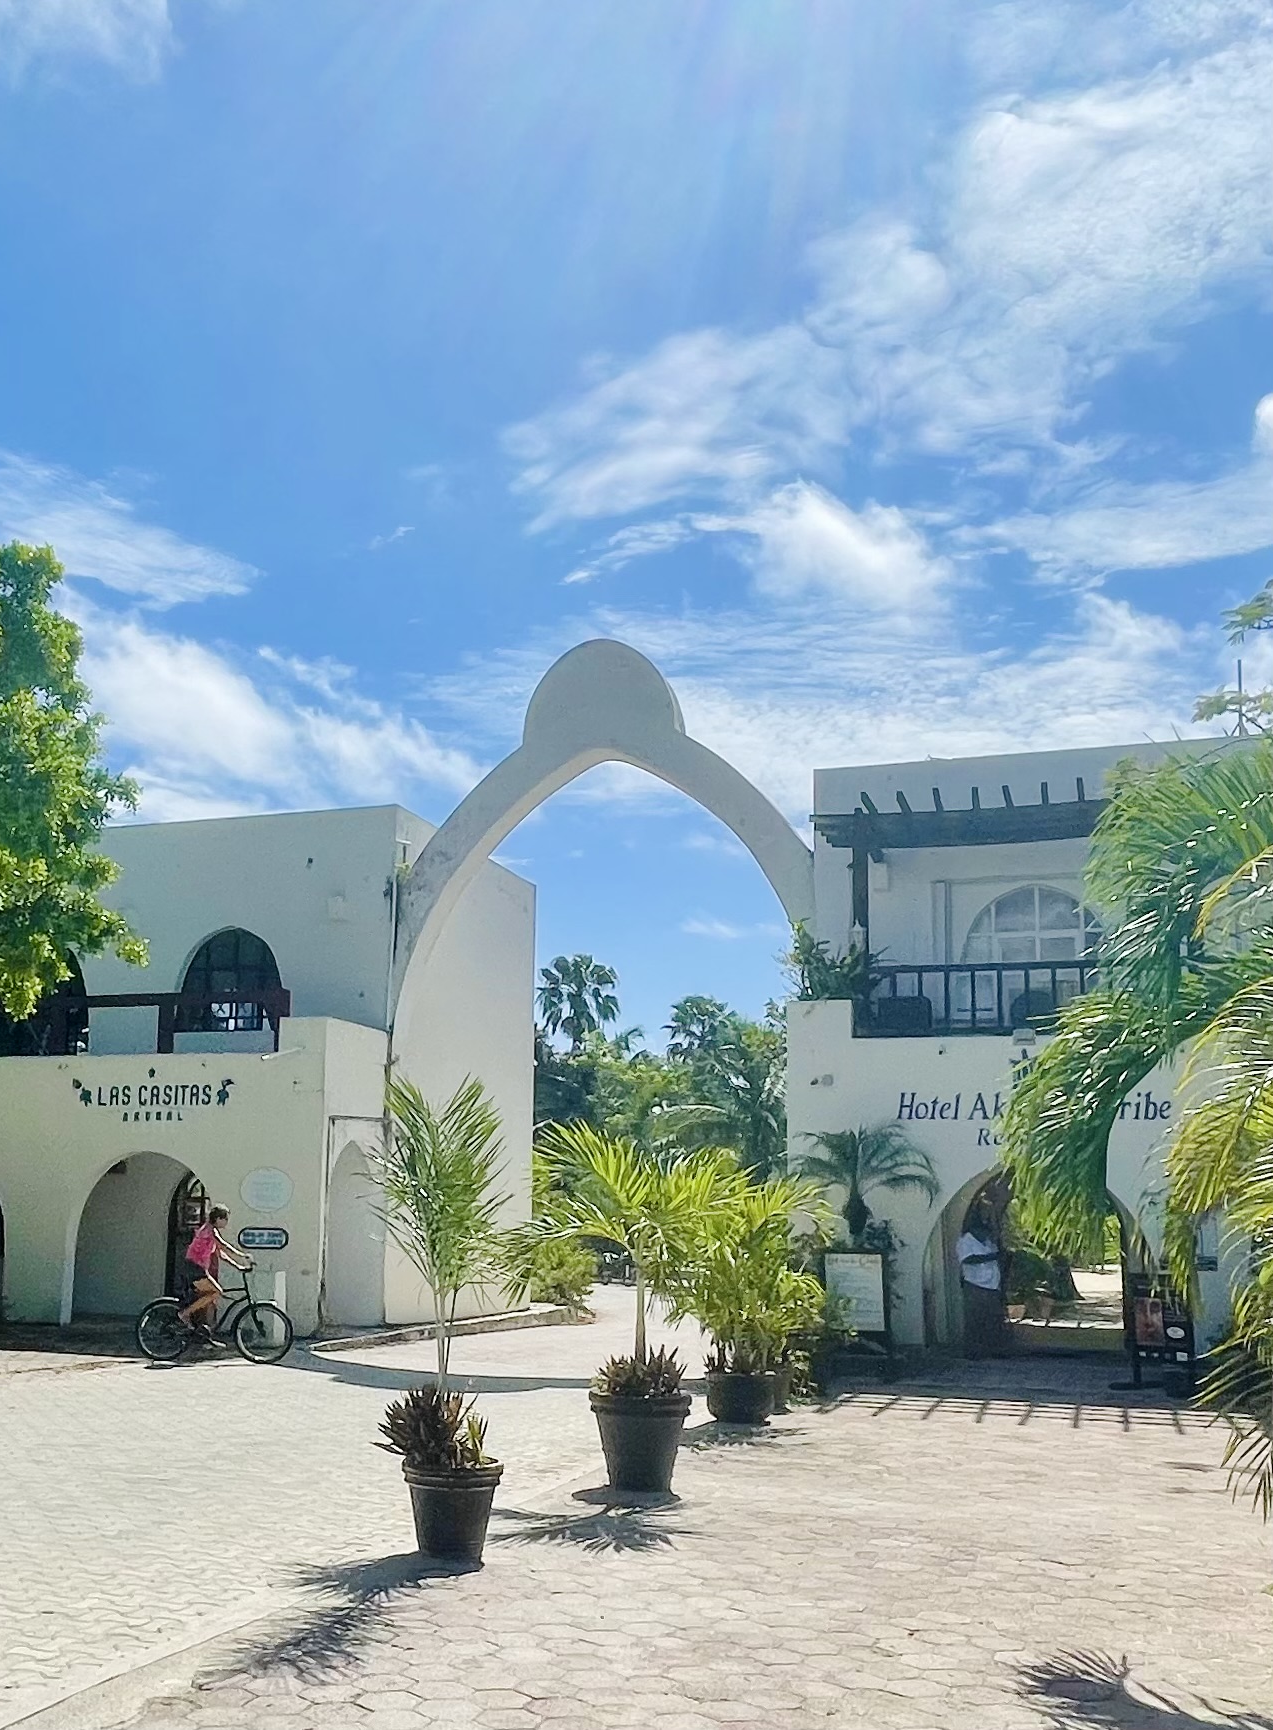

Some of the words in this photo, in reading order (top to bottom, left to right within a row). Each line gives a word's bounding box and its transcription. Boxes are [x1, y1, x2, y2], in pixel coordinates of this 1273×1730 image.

[97, 1085, 132, 1106] LAS
[138, 1084, 212, 1106] CASITAS
[896, 1092, 962, 1120] Hotel
[1118, 1091, 1172, 1120] ribe
